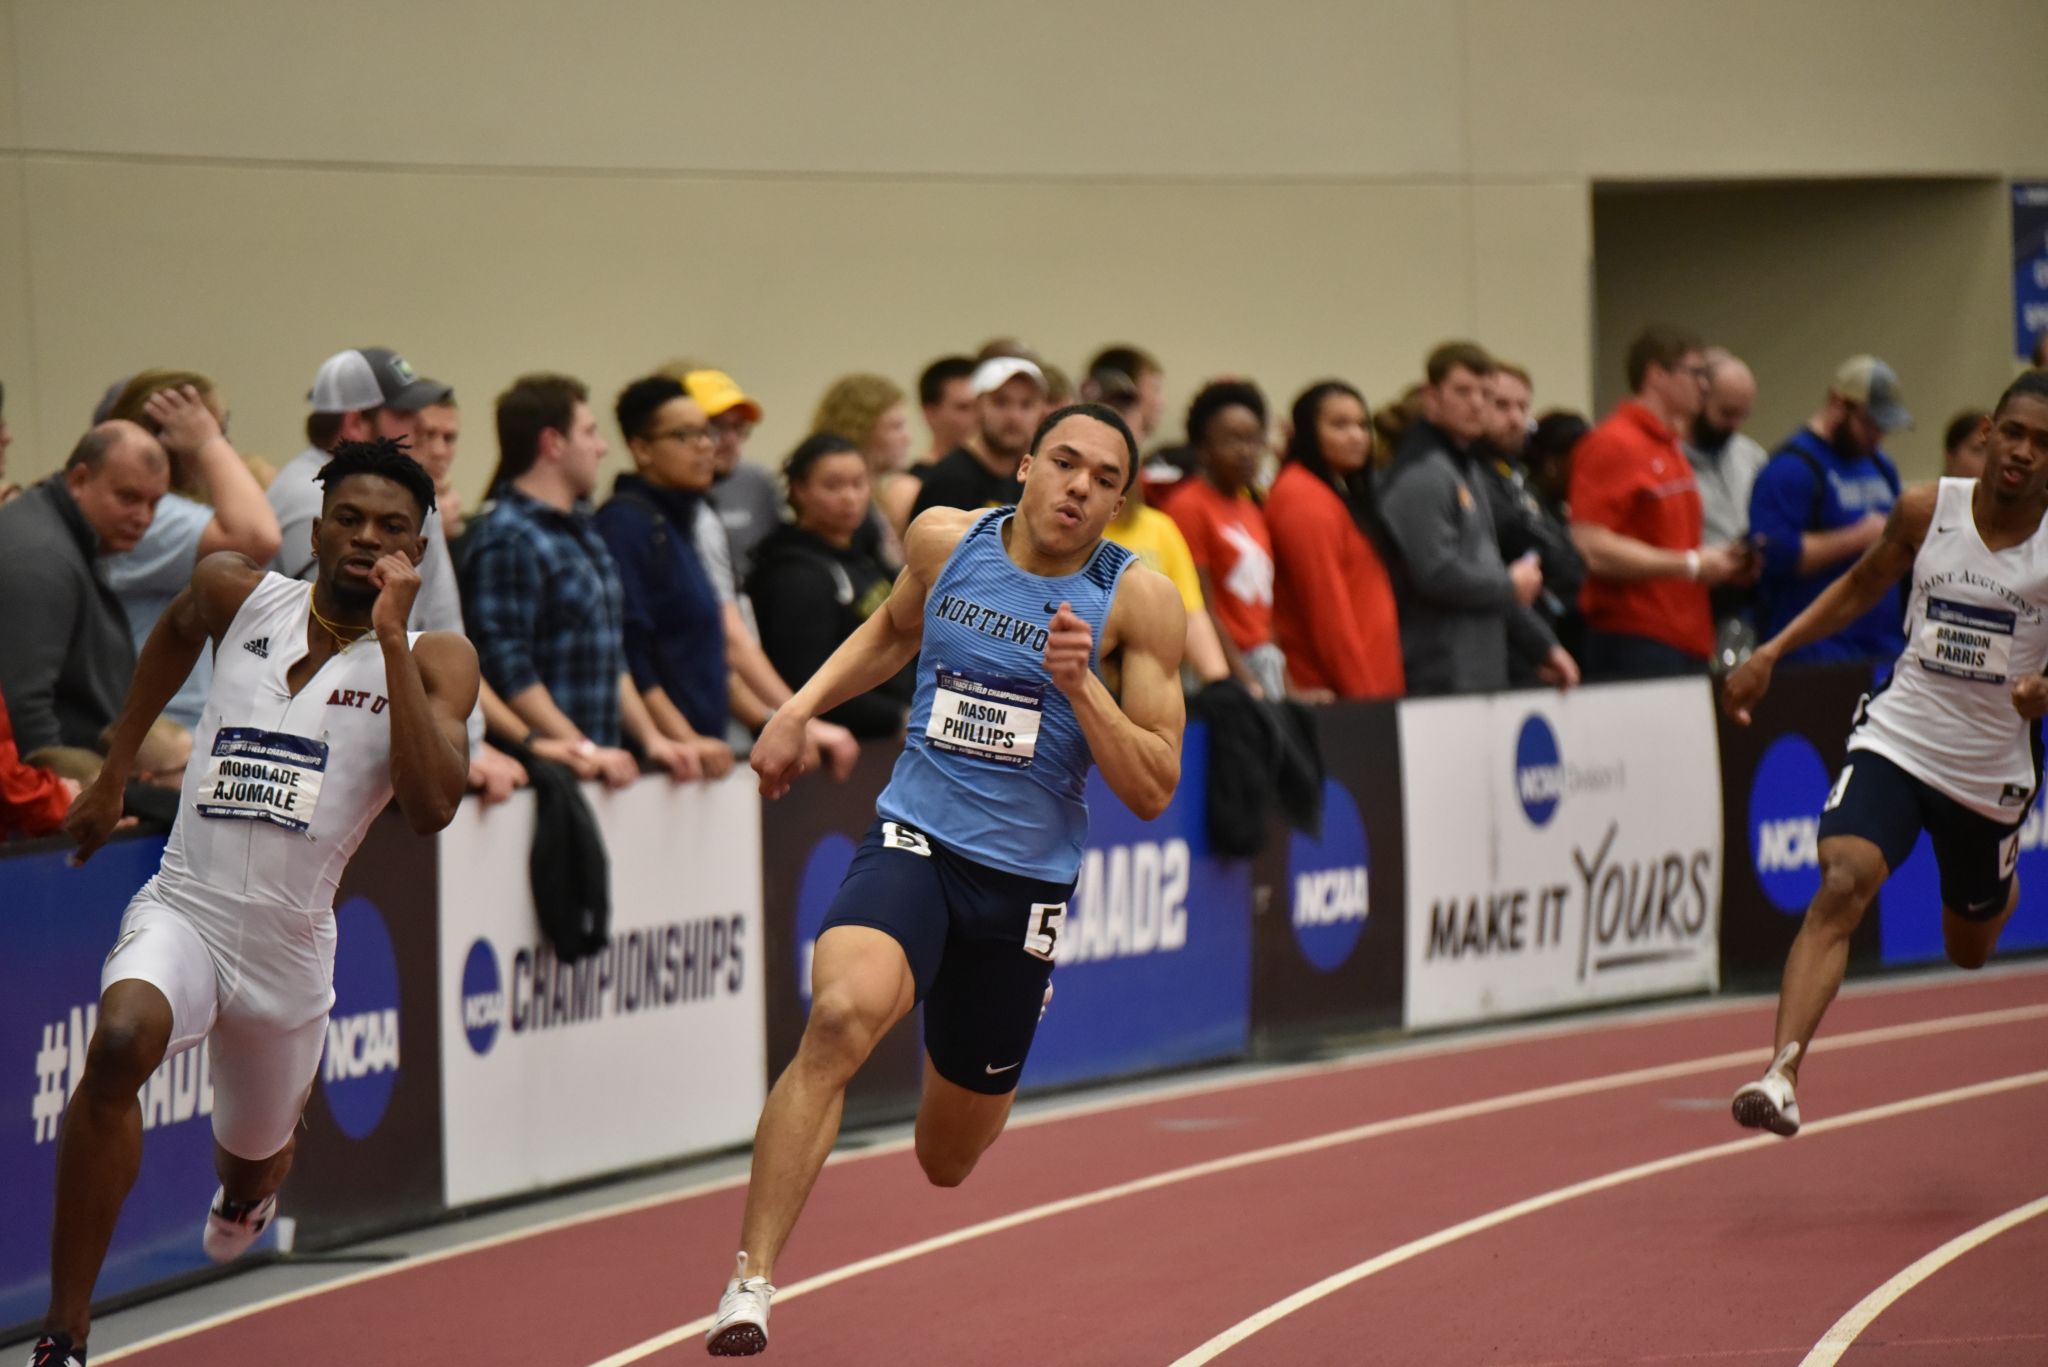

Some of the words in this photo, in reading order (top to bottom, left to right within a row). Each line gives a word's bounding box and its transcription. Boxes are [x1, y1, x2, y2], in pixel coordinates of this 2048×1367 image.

[1936, 627, 1991, 650] BRANDON
[1936, 643, 1986, 667] PARRIS
[326, 690, 371, 708] ART
[370, 696, 388, 714] U
[987, 688, 1038, 705] CHAMPIONSHIPS
[957, 700, 1007, 725] MASON
[942, 717, 1015, 749] PHILLIPS
[219, 760, 300, 787] MOBOLADE
[213, 781, 298, 811] AJOMALE
[1757, 817, 1820, 874] NCA
[1293, 865, 1370, 928] NCAA
[1424, 891, 1525, 961] MAKE
[1535, 883, 1568, 948] IT
[1573, 818, 1711, 982] YOURS
[1038, 907, 1062, 954] 5
[511, 912, 745, 1036] CHAMPIONSHIPS
[323, 1008, 400, 1084] NCAA
